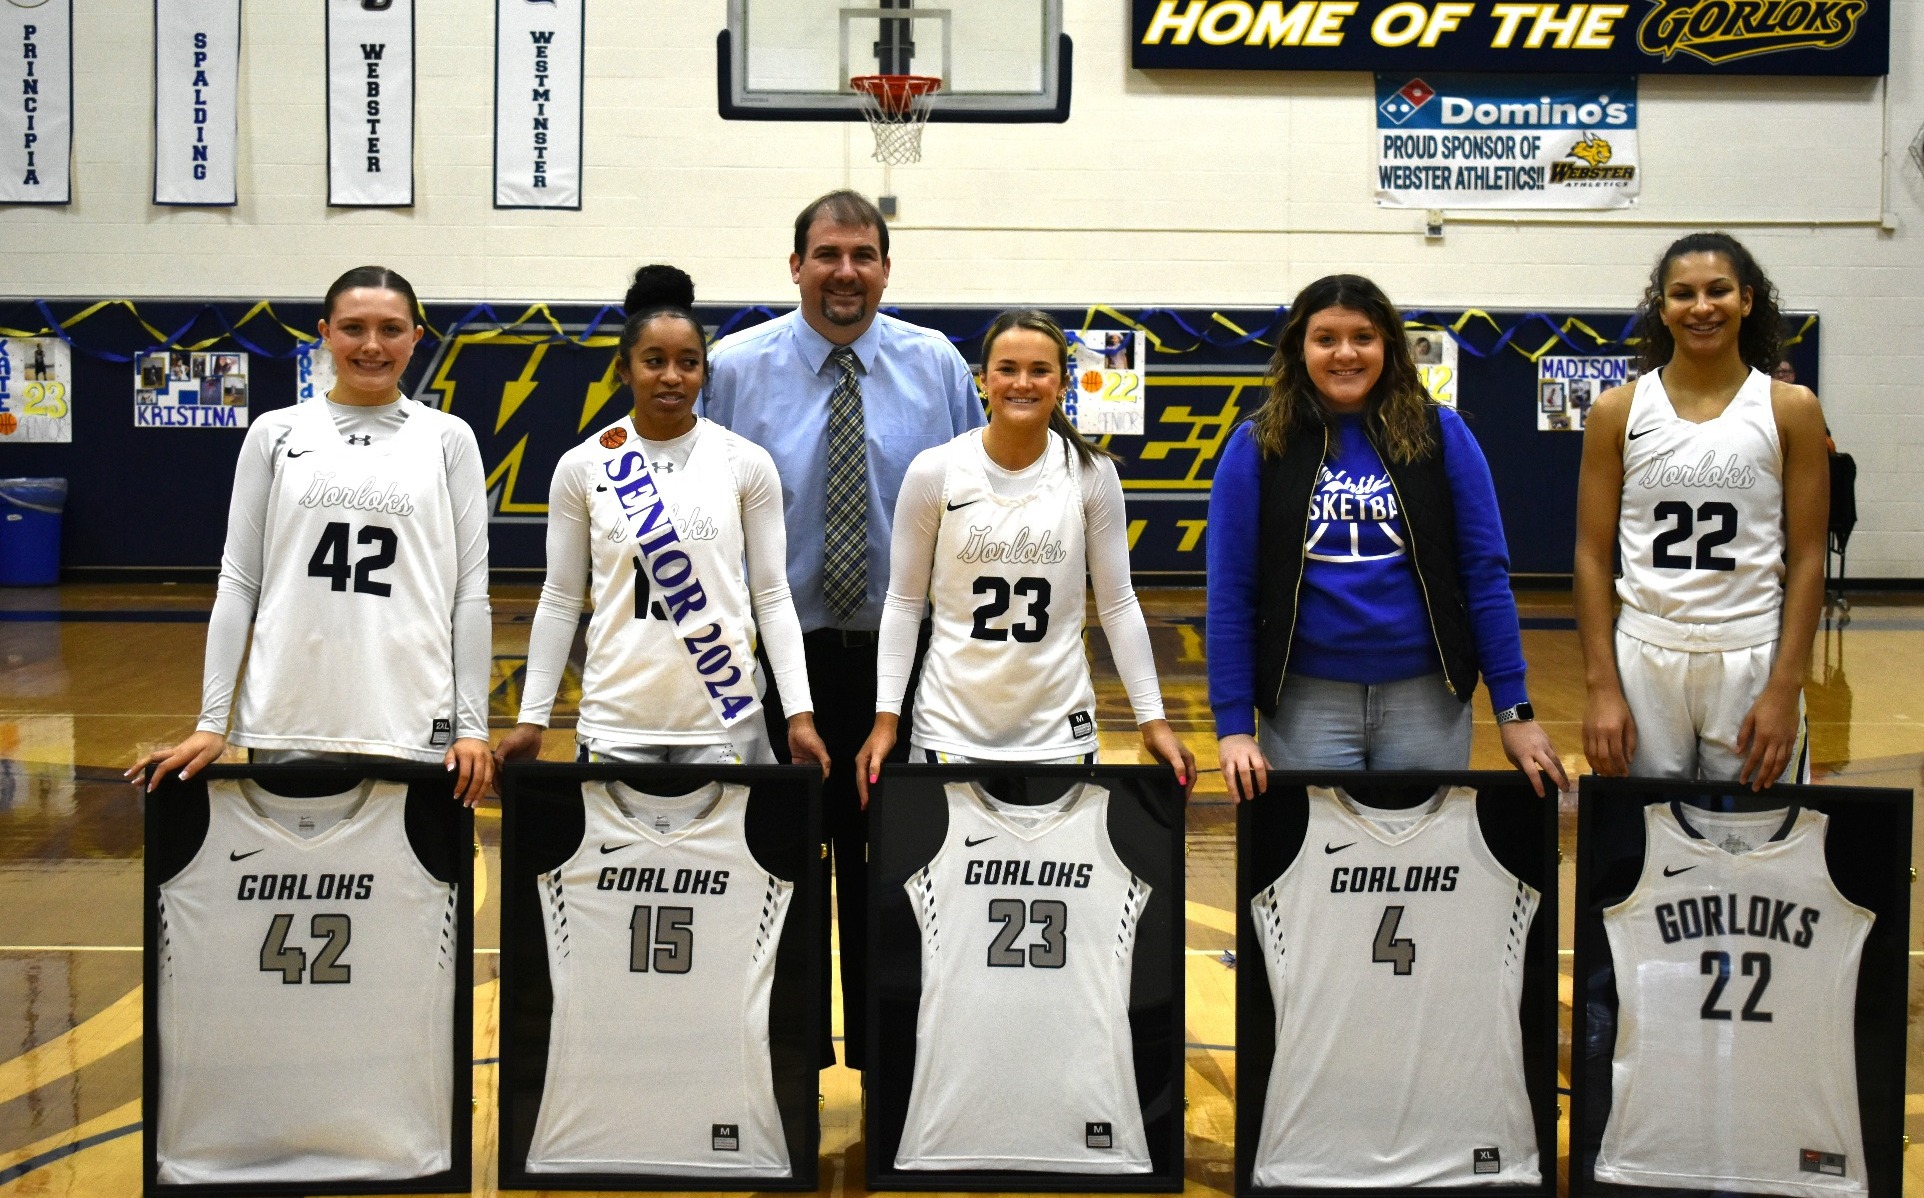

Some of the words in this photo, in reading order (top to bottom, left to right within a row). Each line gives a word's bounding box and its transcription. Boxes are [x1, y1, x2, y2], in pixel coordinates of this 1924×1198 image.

[1141, 0, 1359, 49] HOME
[1370, 3, 1473, 48] OF
[1490, 4, 1629, 49] THE
[1637, 0, 1868, 65] GORLOKS
[23, 25, 39, 185] PRINCIPIA
[193, 33, 207, 180] SPALDING
[361, 44, 385, 172] WEBSTER
[530, 31, 555, 188] WESTMINSTER
[1441, 95, 1628, 125] Domino's
[1383, 135, 1437, 160] PROUD
[1442, 136, 1516, 160] SPONSOR
[1520, 136, 1541, 160] OF
[1379, 165, 1451, 190] WEBSTER
[1455, 166, 1545, 190] ATHLETICS!!
[1549, 161, 1635, 184] WEBSTER
[1102, 371, 1139, 403] 22
[1542, 358, 1627, 379] MADISON
[23, 382, 68, 419] 23
[138, 405, 237, 427] KRISTINA
[1639, 450, 1755, 489] Gorloks
[299, 471, 414, 516] Gorloks
[1308, 494, 1398, 520] SKETBA
[957, 525, 1066, 564] Gorloks
[1653, 501, 1738, 571] 22
[308, 522, 398, 597] 42
[603, 451, 707, 626] SENIOR
[684, 623, 753, 720] 2024
[970, 576, 1051, 642] 23
[435, 721, 450, 730] 2XL
[1075, 714, 1085, 723] M
[237, 874, 374, 900] GORLOKS
[597, 866, 729, 895] GORLOKS
[964, 859, 1094, 889] GORLOKS
[1330, 865, 1459, 893] GORLOKS
[629, 904, 694, 974] 15
[987, 899, 1067, 969] 23
[1654, 893, 1821, 949] GORLOKS
[259, 913, 351, 985] 42
[1372, 905, 1415, 976] 4
[1700, 950, 1773, 1023] 22
[720, 1127, 730, 1136] M
[1093, 1125, 1103, 1133] M
[1480, 1151, 1493, 1159] XL
